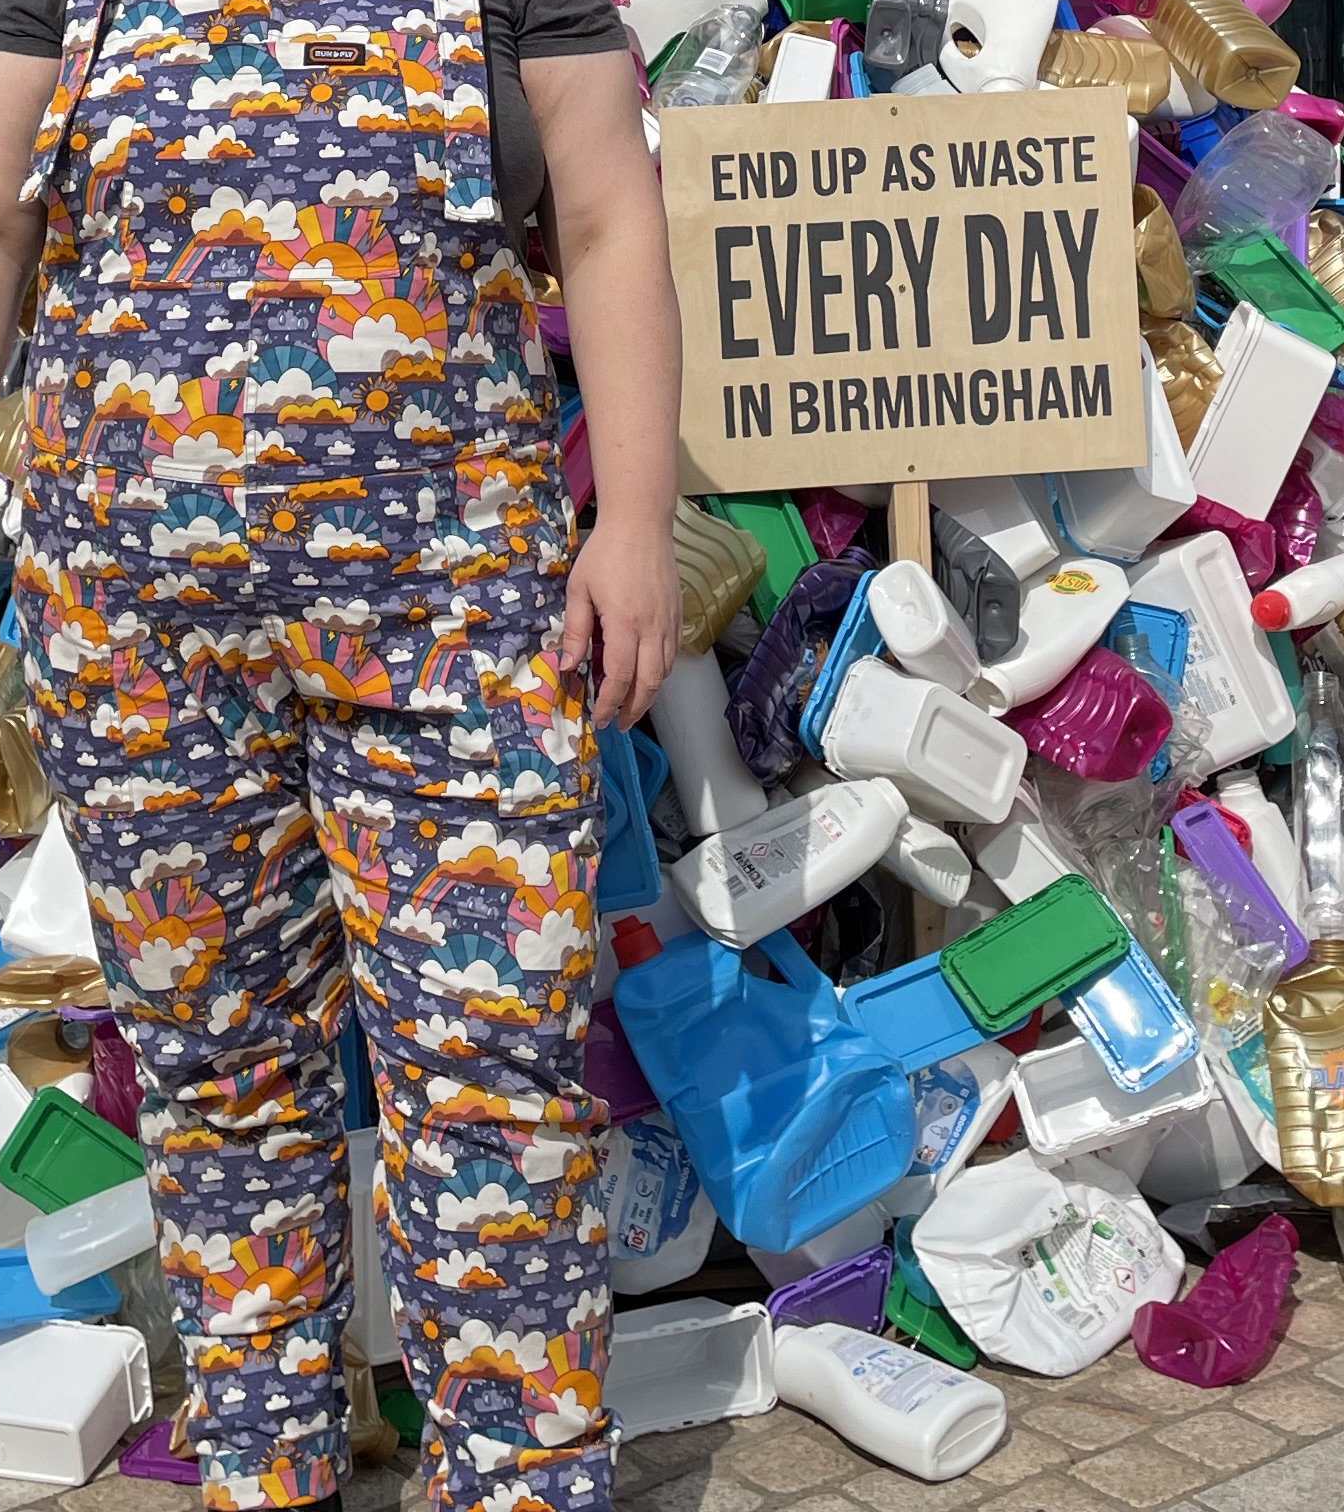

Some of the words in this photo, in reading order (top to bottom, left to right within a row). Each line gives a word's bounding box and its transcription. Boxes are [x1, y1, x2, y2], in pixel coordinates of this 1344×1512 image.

[711, 151, 798, 202] END
[811, 147, 867, 197] UP
[881, 143, 936, 192] AS
[947, 135, 1098, 189] WASTE
[714, 216, 940, 360] EVERY
[964, 208, 1100, 345] DAY
[723, 382, 773, 439] IN
[789, 363, 1113, 435] BIRMINGHAM
[630, 1228, 646, 1249] 105
